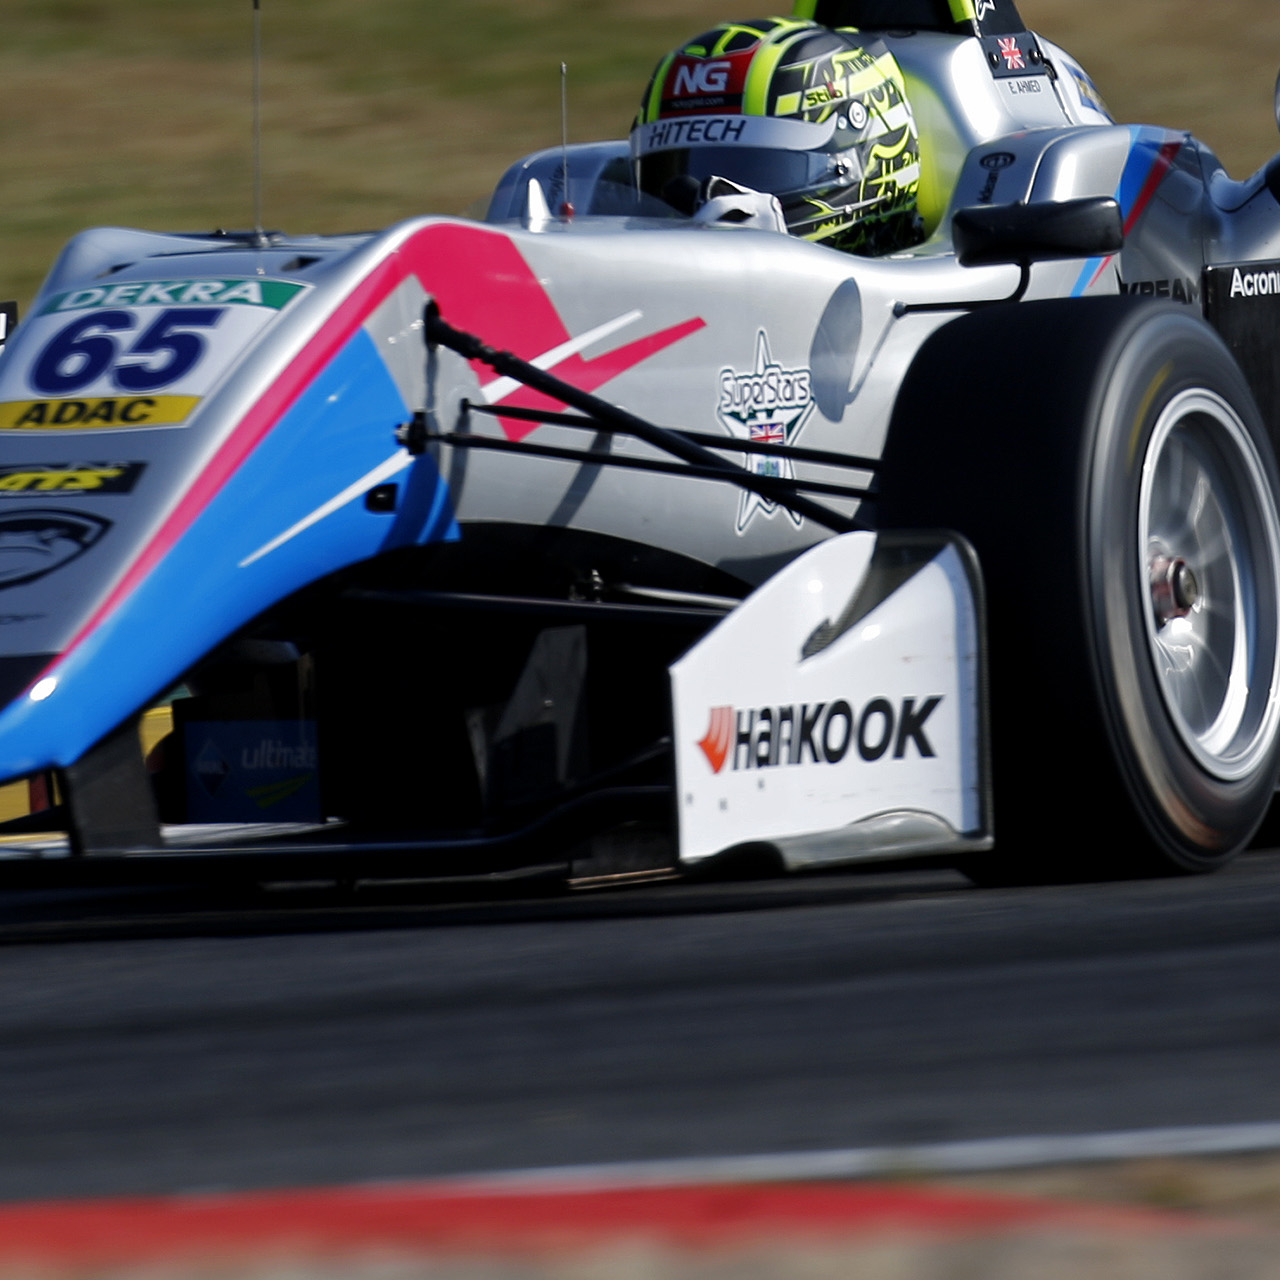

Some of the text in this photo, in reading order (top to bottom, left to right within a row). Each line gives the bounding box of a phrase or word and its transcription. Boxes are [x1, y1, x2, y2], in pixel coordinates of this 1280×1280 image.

[673, 60, 731, 96] NG
[648, 118, 747, 148] HITECH
[58, 279, 262, 311] DEKRA
[29, 307, 230, 397] 65
[14, 398, 157, 429] ADAC
